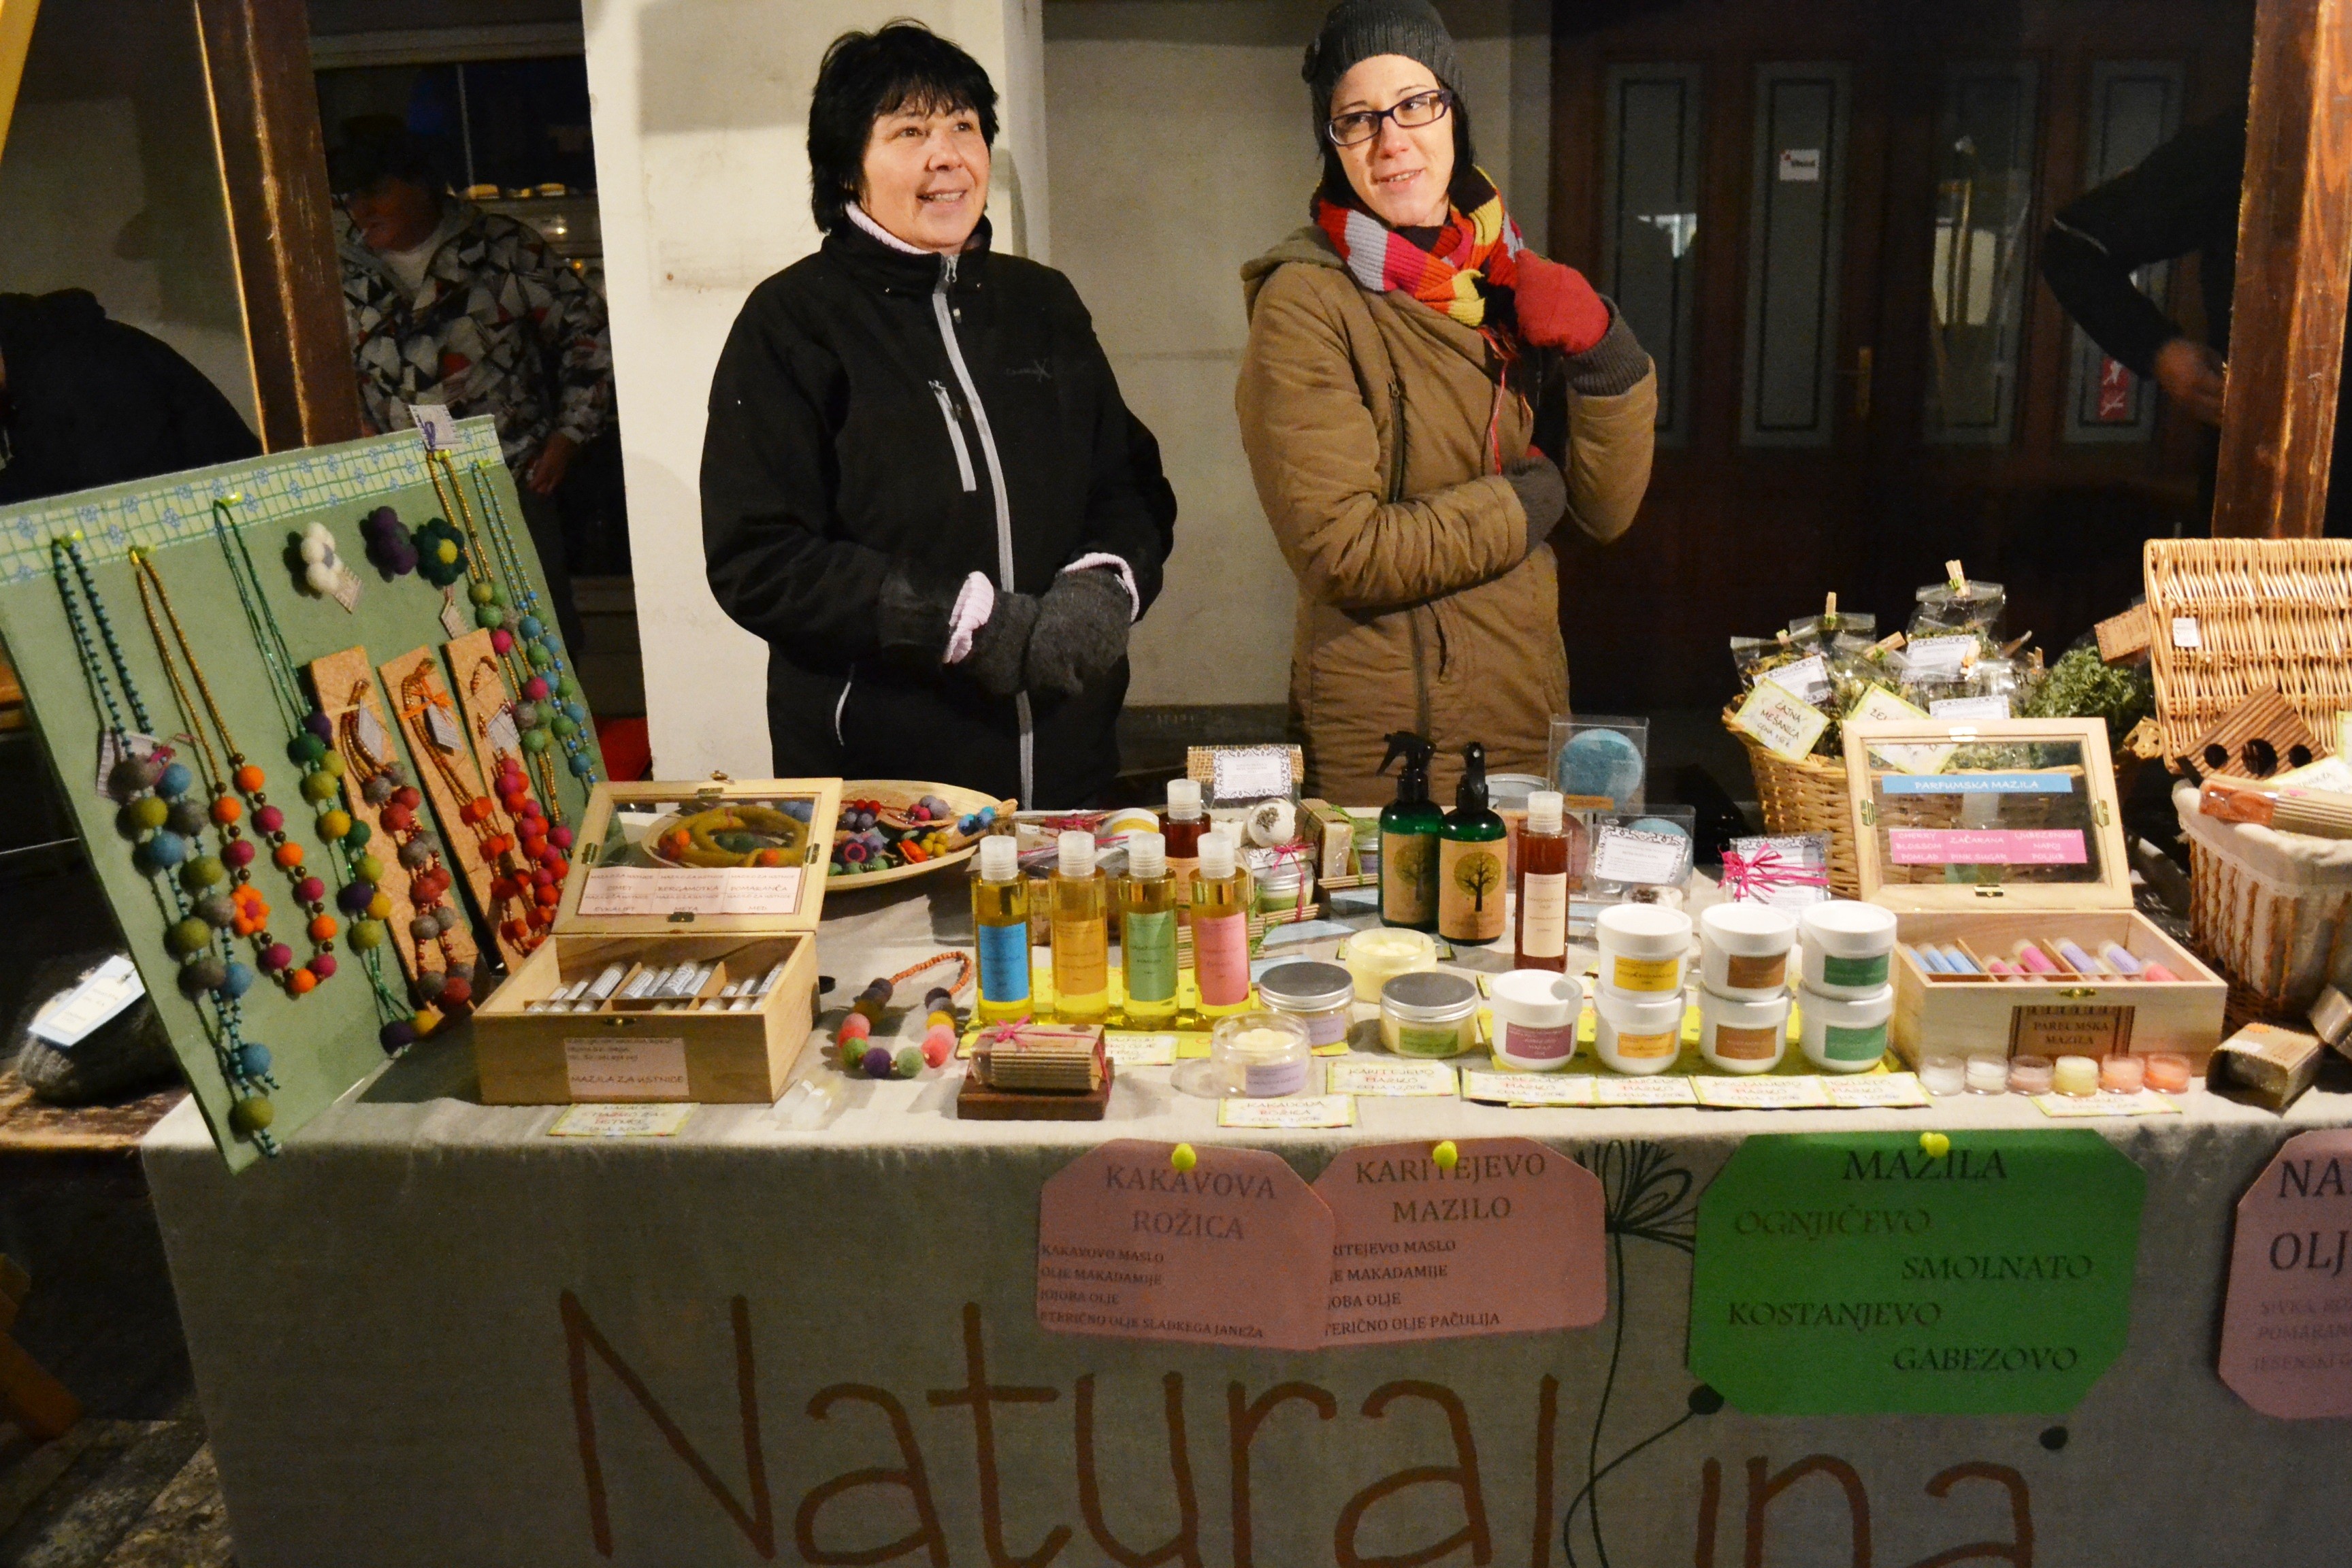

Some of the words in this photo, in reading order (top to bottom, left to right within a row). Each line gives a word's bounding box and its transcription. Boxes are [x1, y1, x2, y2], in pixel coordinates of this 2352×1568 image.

[1914, 781, 1989, 790] PARFUMSKA
[1991, 780, 2039, 789] MAZILA
[1898, 832, 1937, 840] CHERRY
[1949, 834, 2005, 844] ZAČARANA
[1901, 853, 1939, 861] POMLAD
[1356, 1152, 1546, 1184] KARITEJEVO
[1842, 1149, 2008, 1181] MAZILA
[1106, 1165, 1277, 1199] KAKAVOVA
[2278, 1157, 2352, 1199] NA
[1392, 1195, 1512, 1222] MAZILO
[1132, 1209, 1245, 1240] ROŽICA
[1733, 1203, 1932, 1241] OGNJIČEVO
[1041, 1245, 1114, 1260] KAKAVOVO
[1117, 1249, 1164, 1264] MASLO
[1404, 1239, 1456, 1254] MASLO
[1041, 1267, 1074, 1279] OLJE
[1075, 1268, 1163, 1286] MAKADAMIJE
[1347, 1264, 1448, 1281] MAKADAMIJE
[1901, 1254, 2094, 1280] SMOLNATO
[1039, 1290, 1085, 1303] JOJOBA
[1090, 1292, 1120, 1305] OLJE
[1366, 1292, 1402, 1307] OLJE
[1111, 1315, 1139, 1330] OLJE
[1141, 1318, 1211, 1333] SLADKEGA
[1392, 1316, 1426, 1332] OLJE
[1430, 1311, 1500, 1328] PAČULIJA
[1727, 1301, 1943, 1333] KOSTANJEVO
[1893, 1345, 2078, 1373] GABEZOVO
